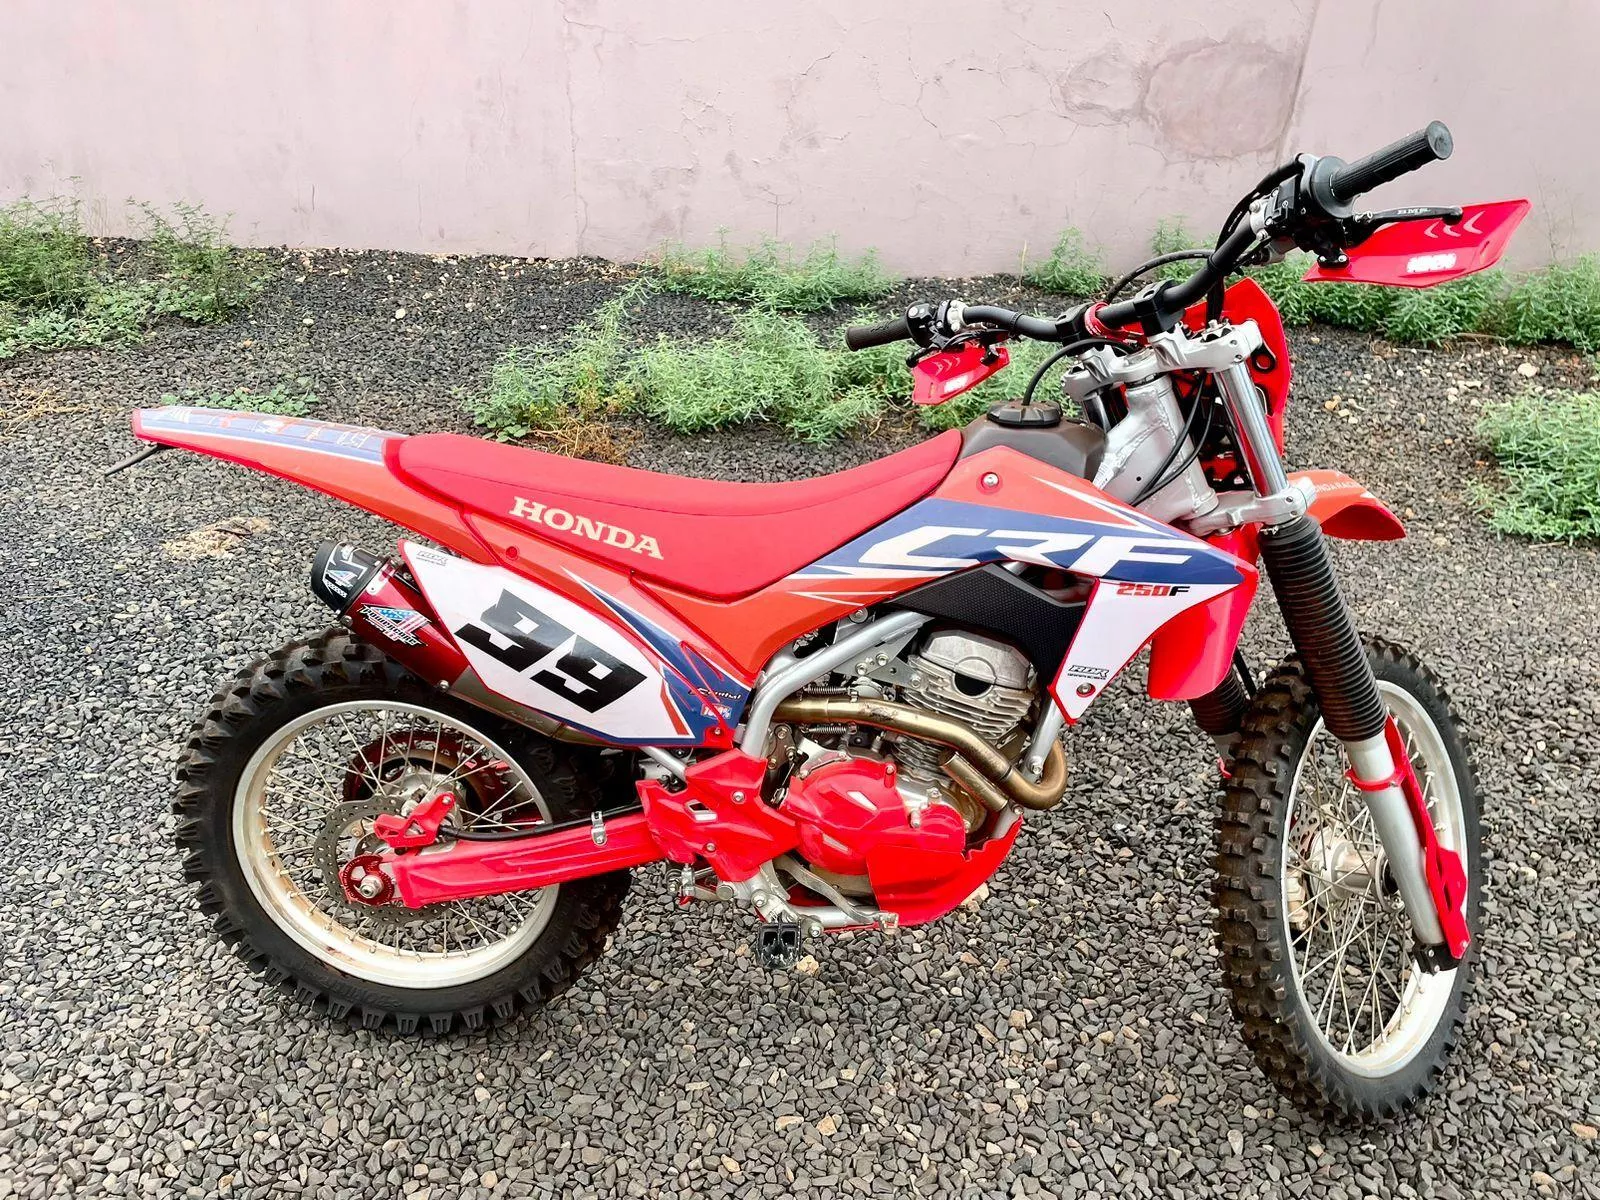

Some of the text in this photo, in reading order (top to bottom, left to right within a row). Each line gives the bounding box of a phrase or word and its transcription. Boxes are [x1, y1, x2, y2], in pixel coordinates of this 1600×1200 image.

[508, 496, 664, 560] HONDA
[857, 525, 1213, 579] CRF
[1116, 582, 1190, 597] 250F
[453, 588, 648, 714] 99
